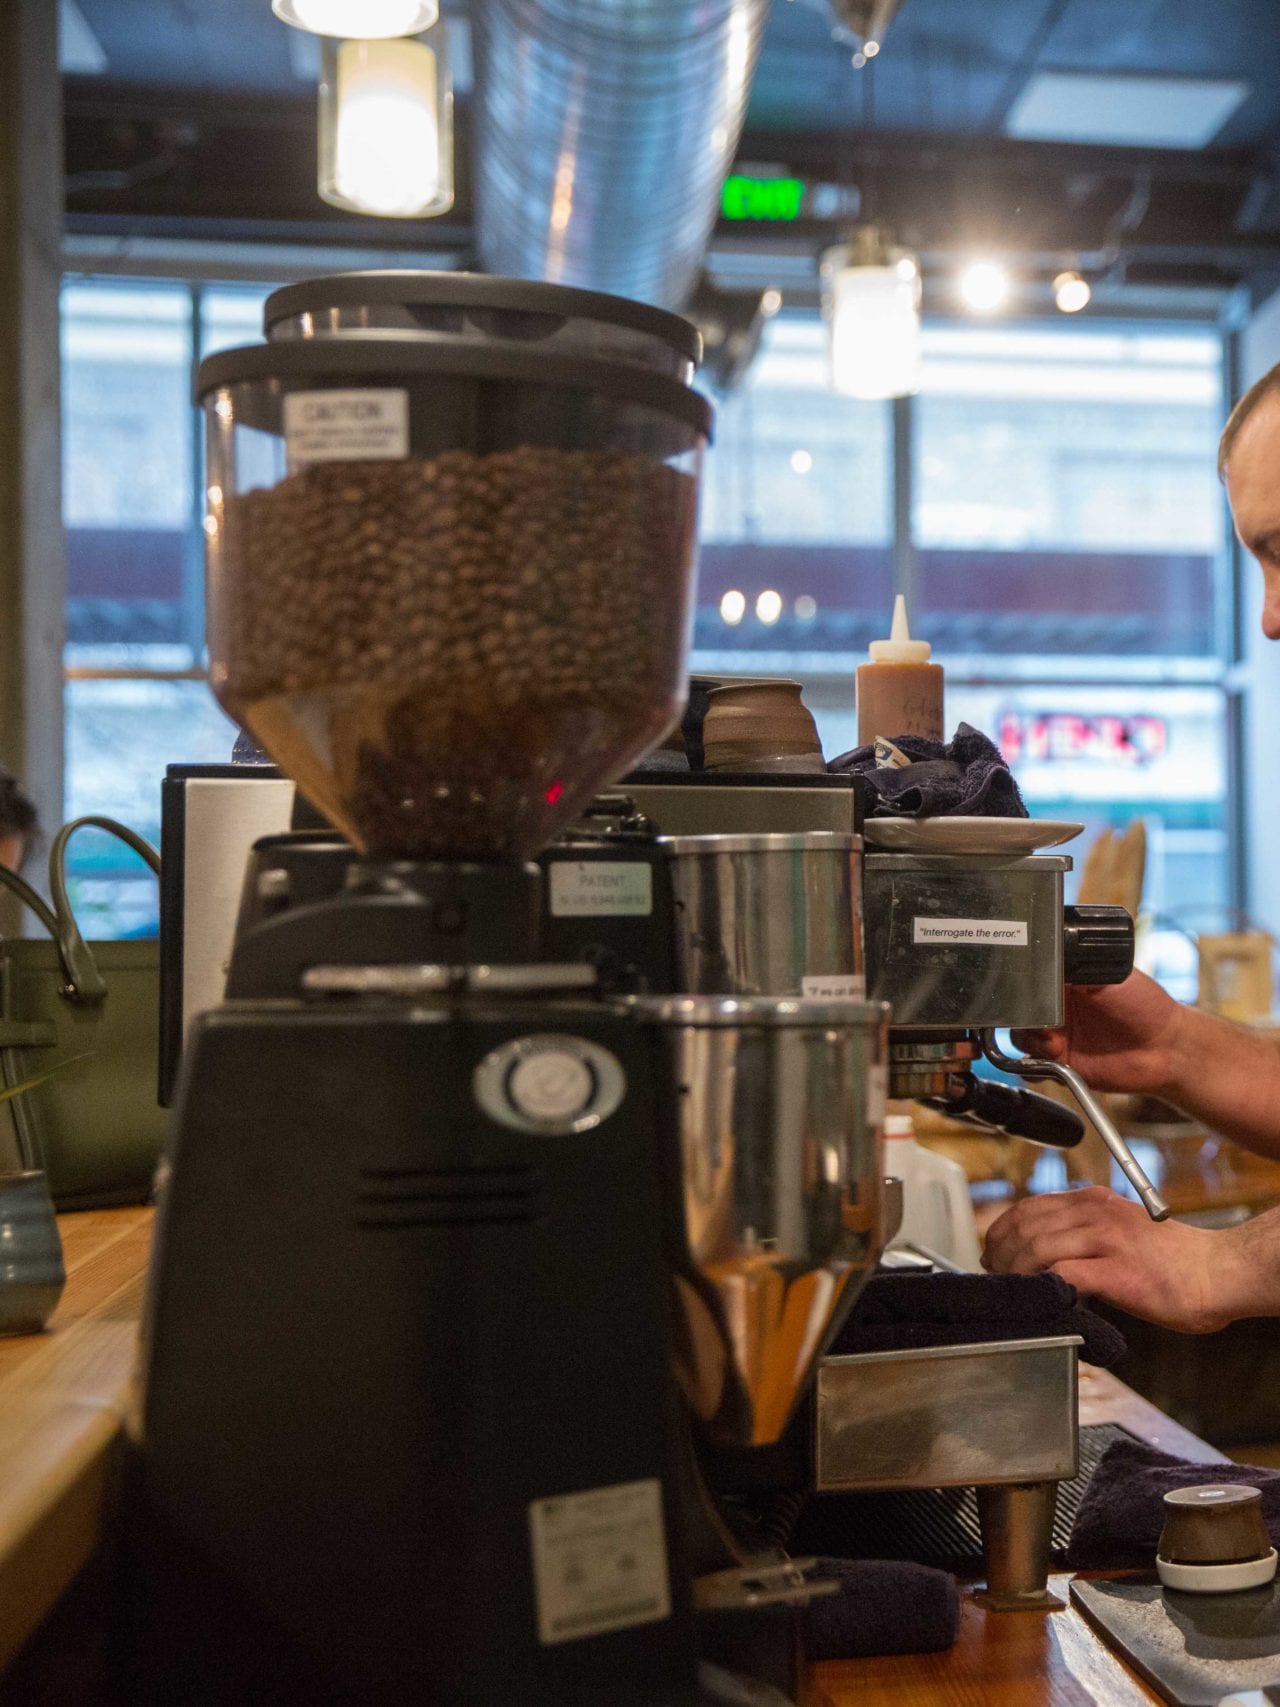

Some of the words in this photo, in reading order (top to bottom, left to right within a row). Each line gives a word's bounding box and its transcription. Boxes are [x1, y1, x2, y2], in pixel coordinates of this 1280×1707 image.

[579, 875, 626, 887] PATENT
[919, 927, 974, 939] "Interrogate
[976, 928, 991, 938] the
